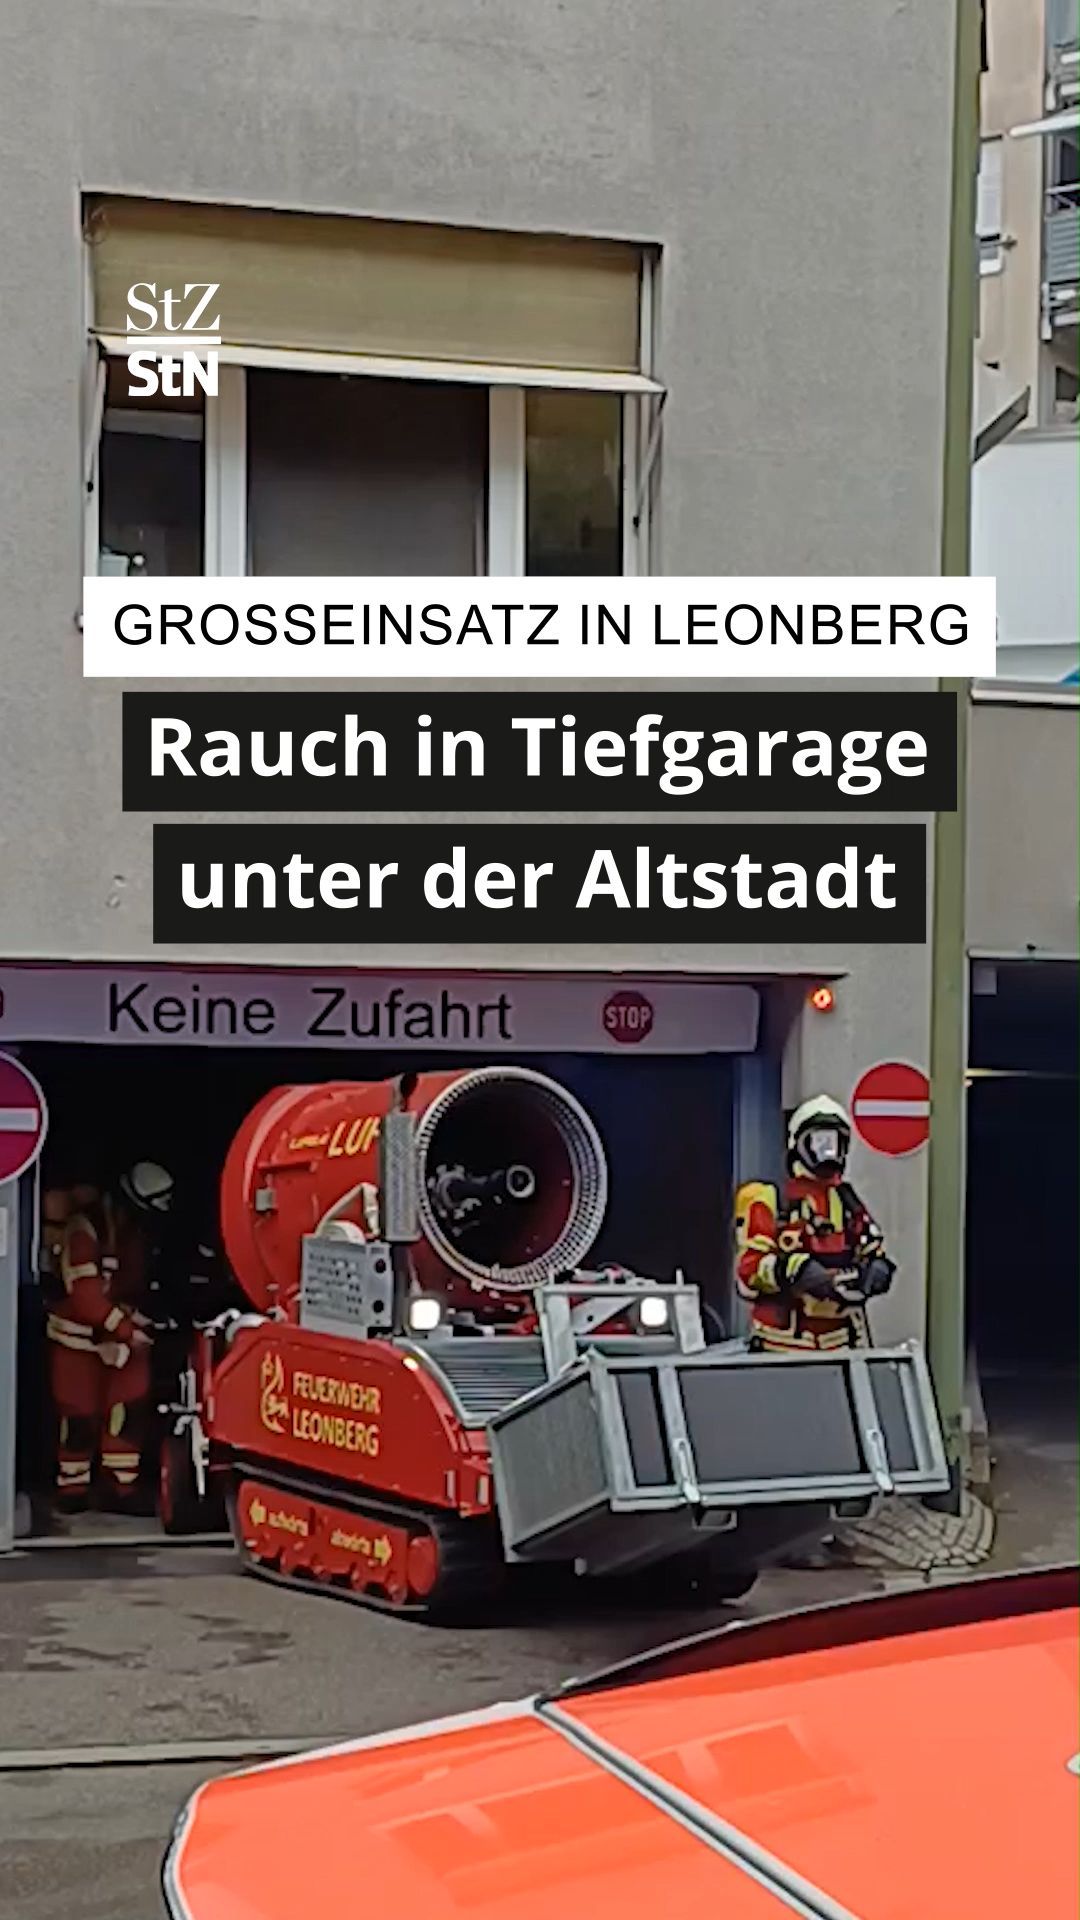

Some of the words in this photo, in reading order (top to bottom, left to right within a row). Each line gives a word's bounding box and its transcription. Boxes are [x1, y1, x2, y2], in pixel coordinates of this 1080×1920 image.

[108, 982, 276, 1035] Keine
[306, 986, 512, 1040] Zufahrt
[605, 1005, 651, 1029] STOP
[292, 1371, 381, 1415] FEUERWEHR
[292, 1407, 381, 1456] LEONBERG
